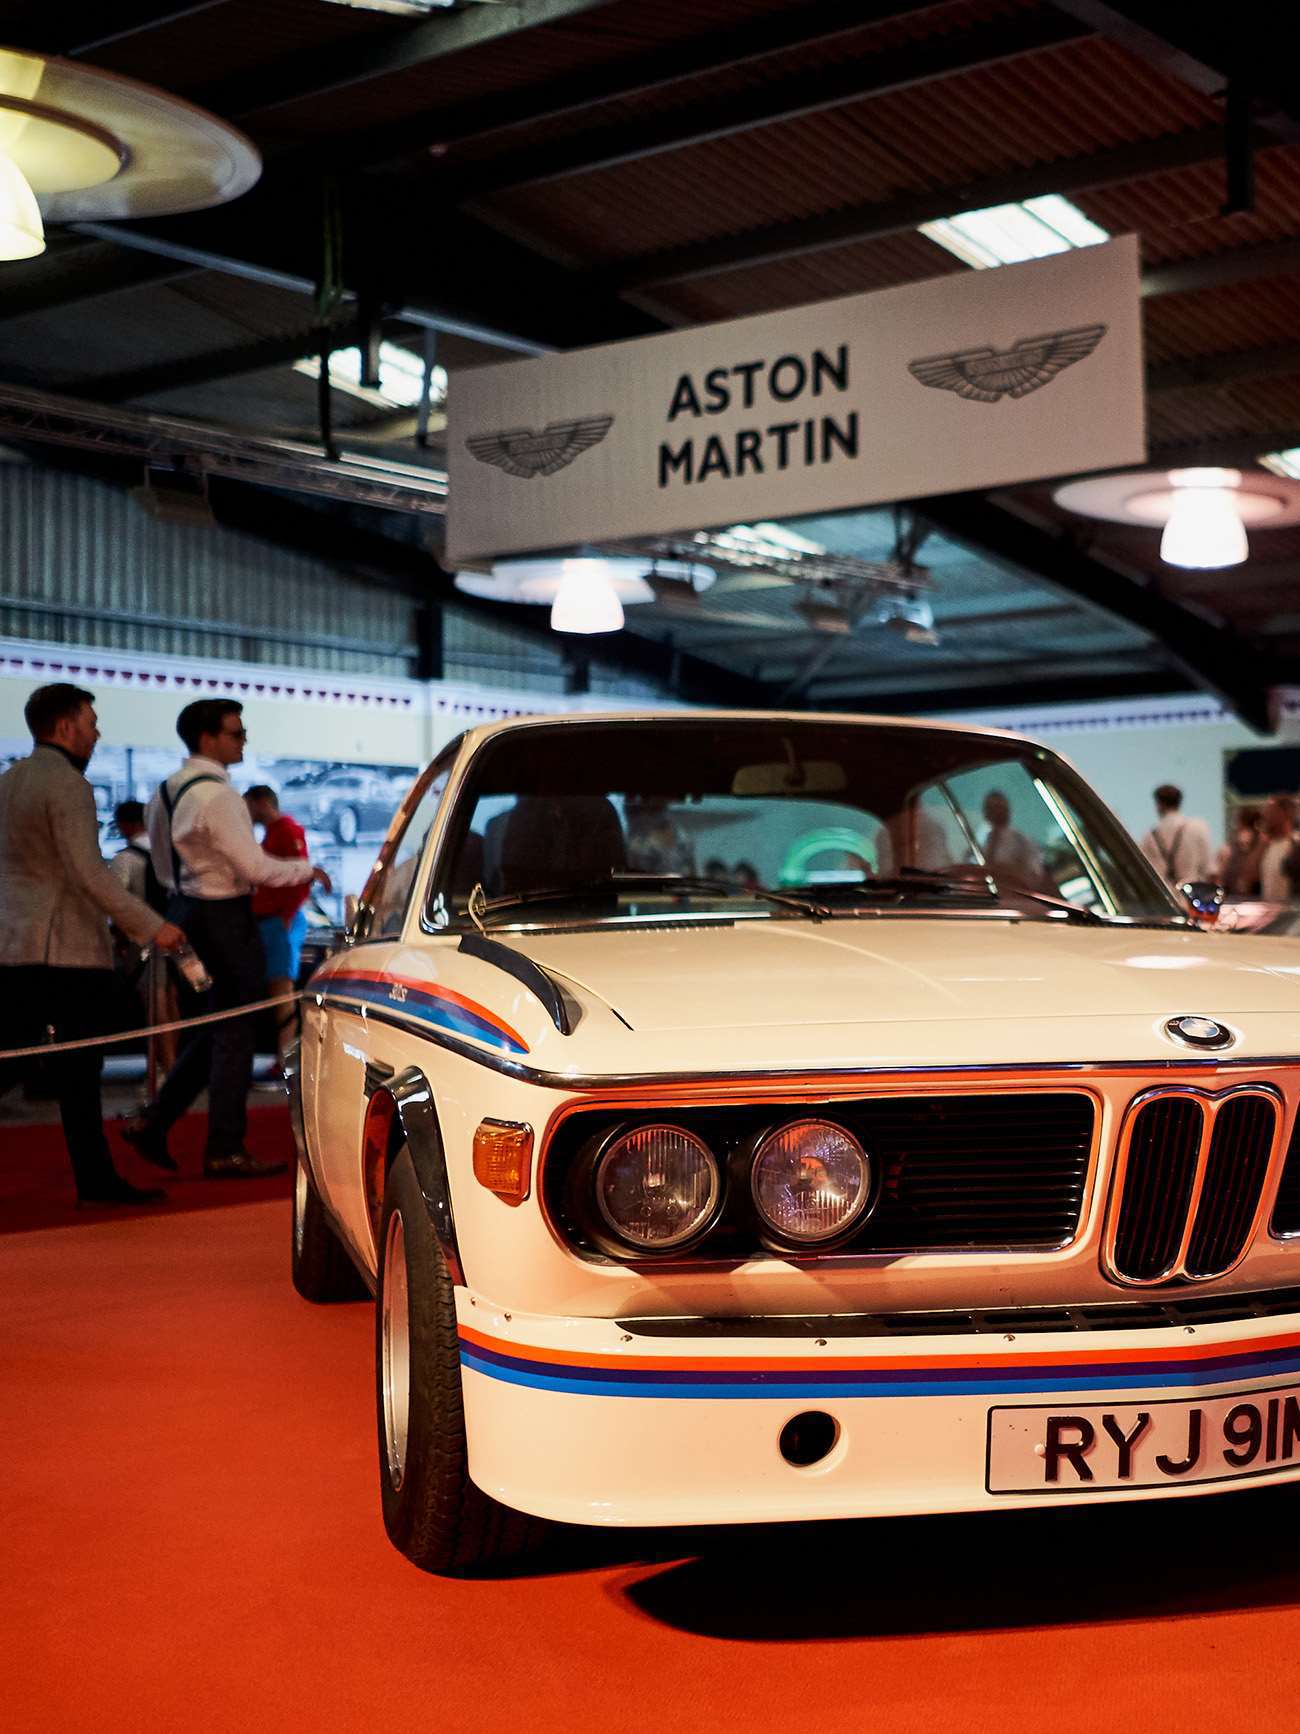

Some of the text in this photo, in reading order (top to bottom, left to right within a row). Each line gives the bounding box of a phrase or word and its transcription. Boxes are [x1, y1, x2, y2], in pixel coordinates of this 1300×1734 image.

[667, 344, 850, 422] ASTON
[658, 412, 860, 489] MARTIN
[1045, 1408, 1202, 1482] RYJ
